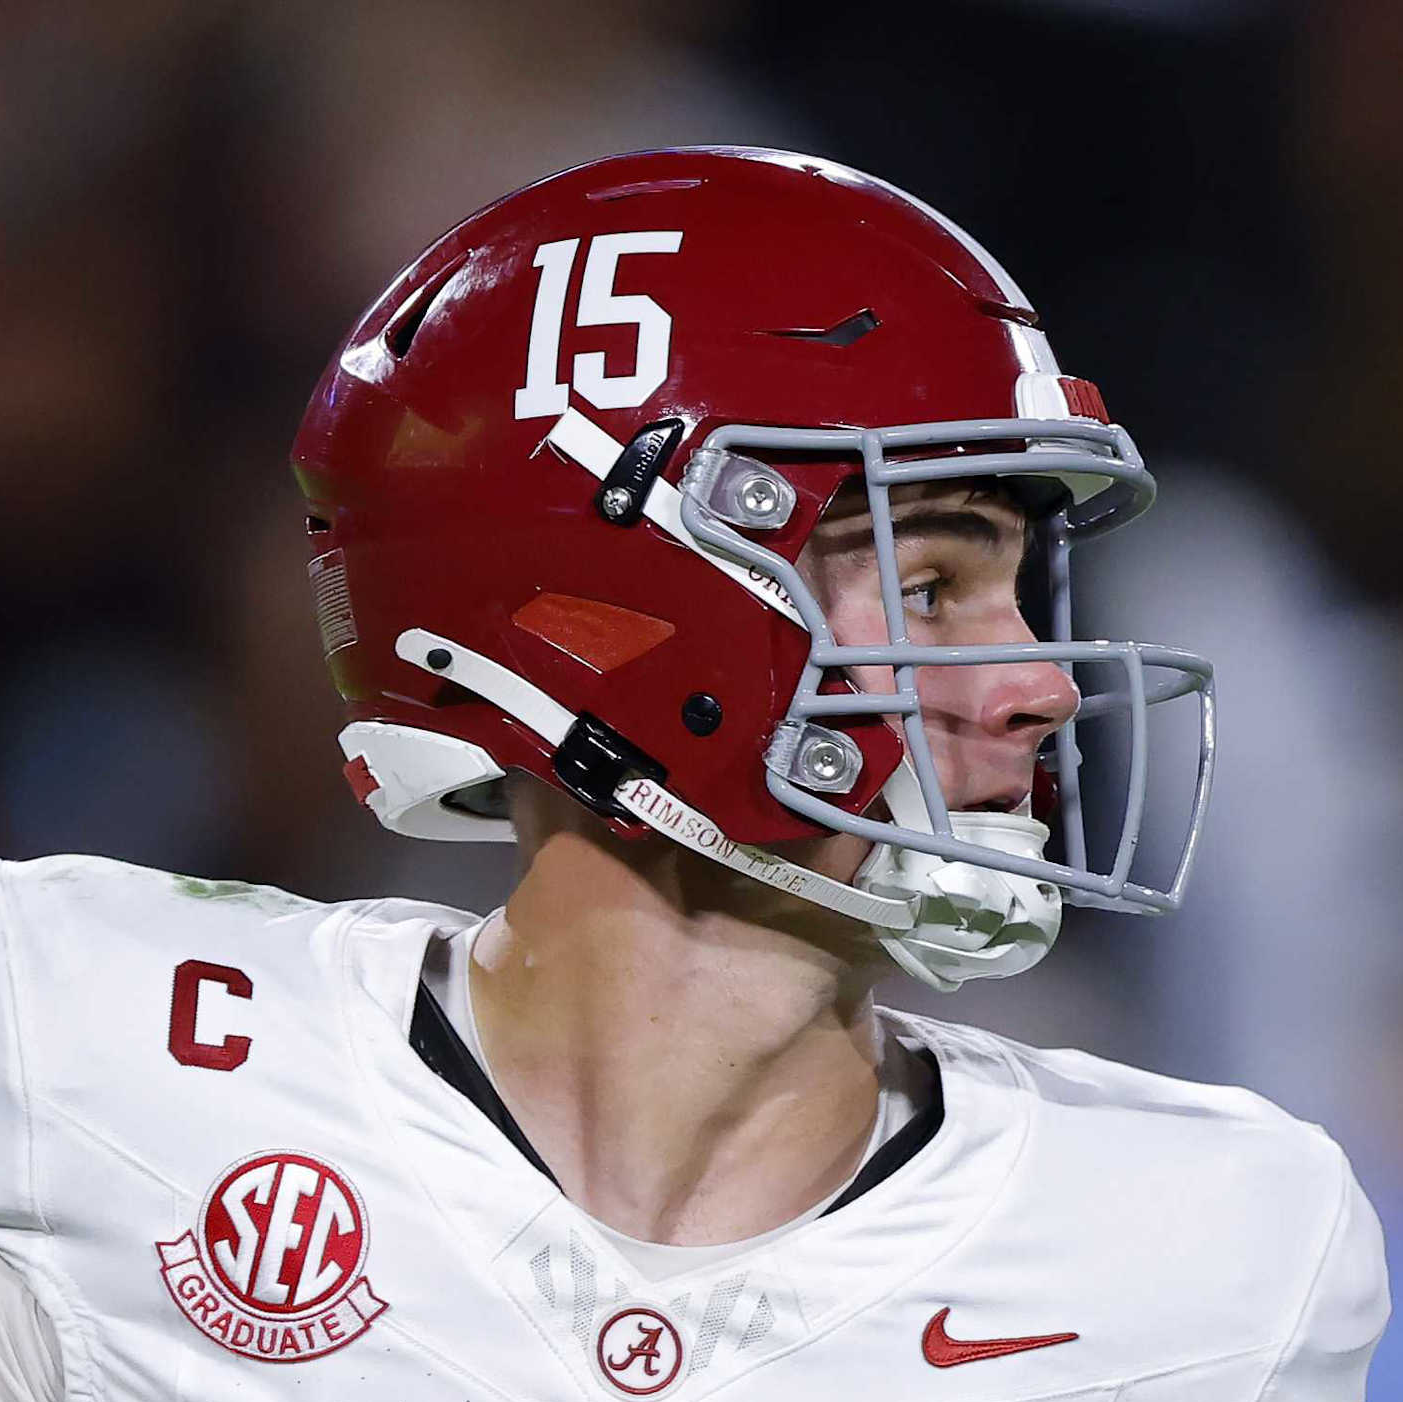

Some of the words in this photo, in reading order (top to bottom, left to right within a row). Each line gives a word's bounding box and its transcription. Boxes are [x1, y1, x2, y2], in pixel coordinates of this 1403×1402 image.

[515, 231, 683, 420] 15
[168, 959, 253, 1072] C
[214, 1161, 357, 1306] SEC
[177, 1274, 346, 1355] GRADUATE
